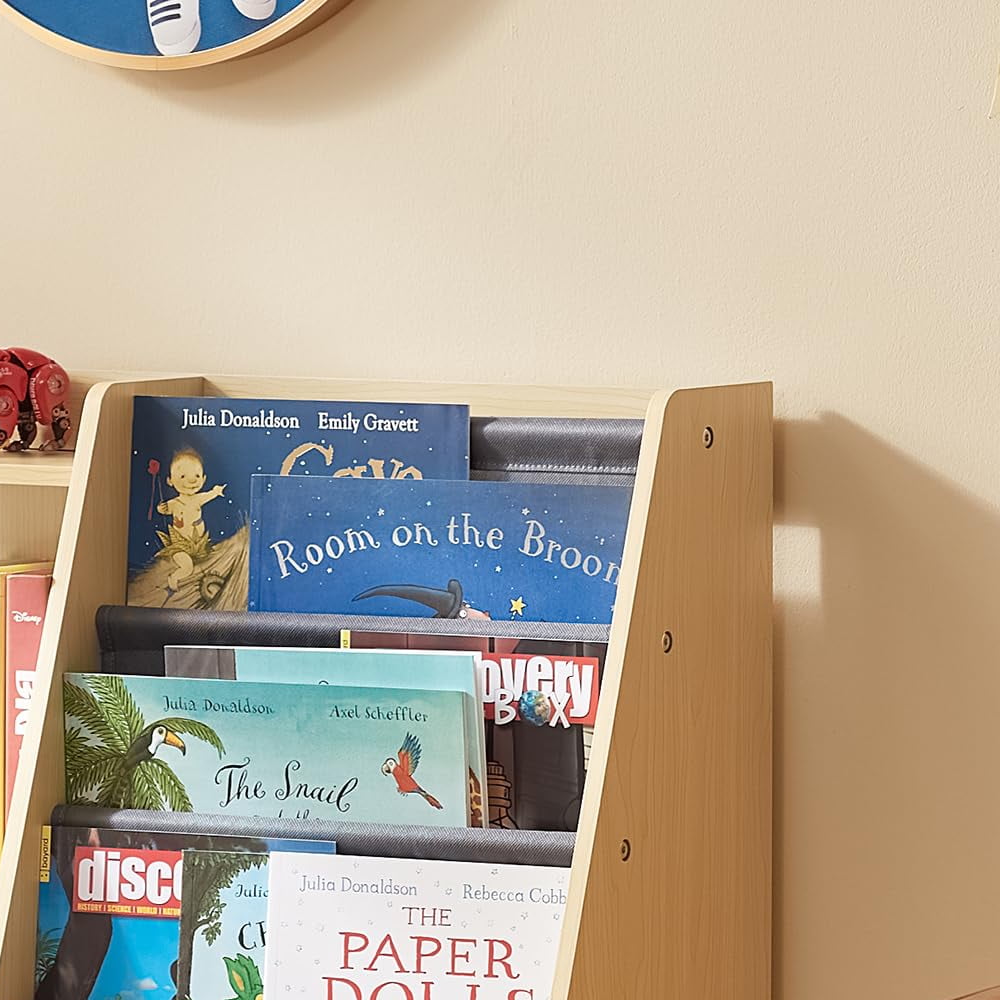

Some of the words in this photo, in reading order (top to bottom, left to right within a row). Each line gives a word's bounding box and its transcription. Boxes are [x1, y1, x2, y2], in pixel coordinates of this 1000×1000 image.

[182, 408, 216, 429] Julia
[220, 409, 300, 429] Donaldson
[318, 412, 360, 434] Emily
[363, 413, 419, 432] Gravett
[269, 527, 381, 579] Room
[391, 522, 439, 548] on
[446, 513, 504, 550] the
[11, 610, 42, 625] Disney
[482, 656, 594, 717] overy
[163, 696, 198, 712] Julia
[202, 699, 275, 715] Donaldson
[329, 705, 361, 719] Axel
[364, 706, 429, 723] Scheffler
[214, 757, 266, 808] The
[275, 760, 358, 812] Snail
[299, 875, 336, 894] Julia
[341, 877, 417, 896] Donaldson
[463, 884, 524, 902] Rebecca
[529, 888, 567, 905] Cobb
[162, 907, 181, 916] NATU
[401, 906, 452, 927] THE
[338, 932, 520, 979] PAPER
